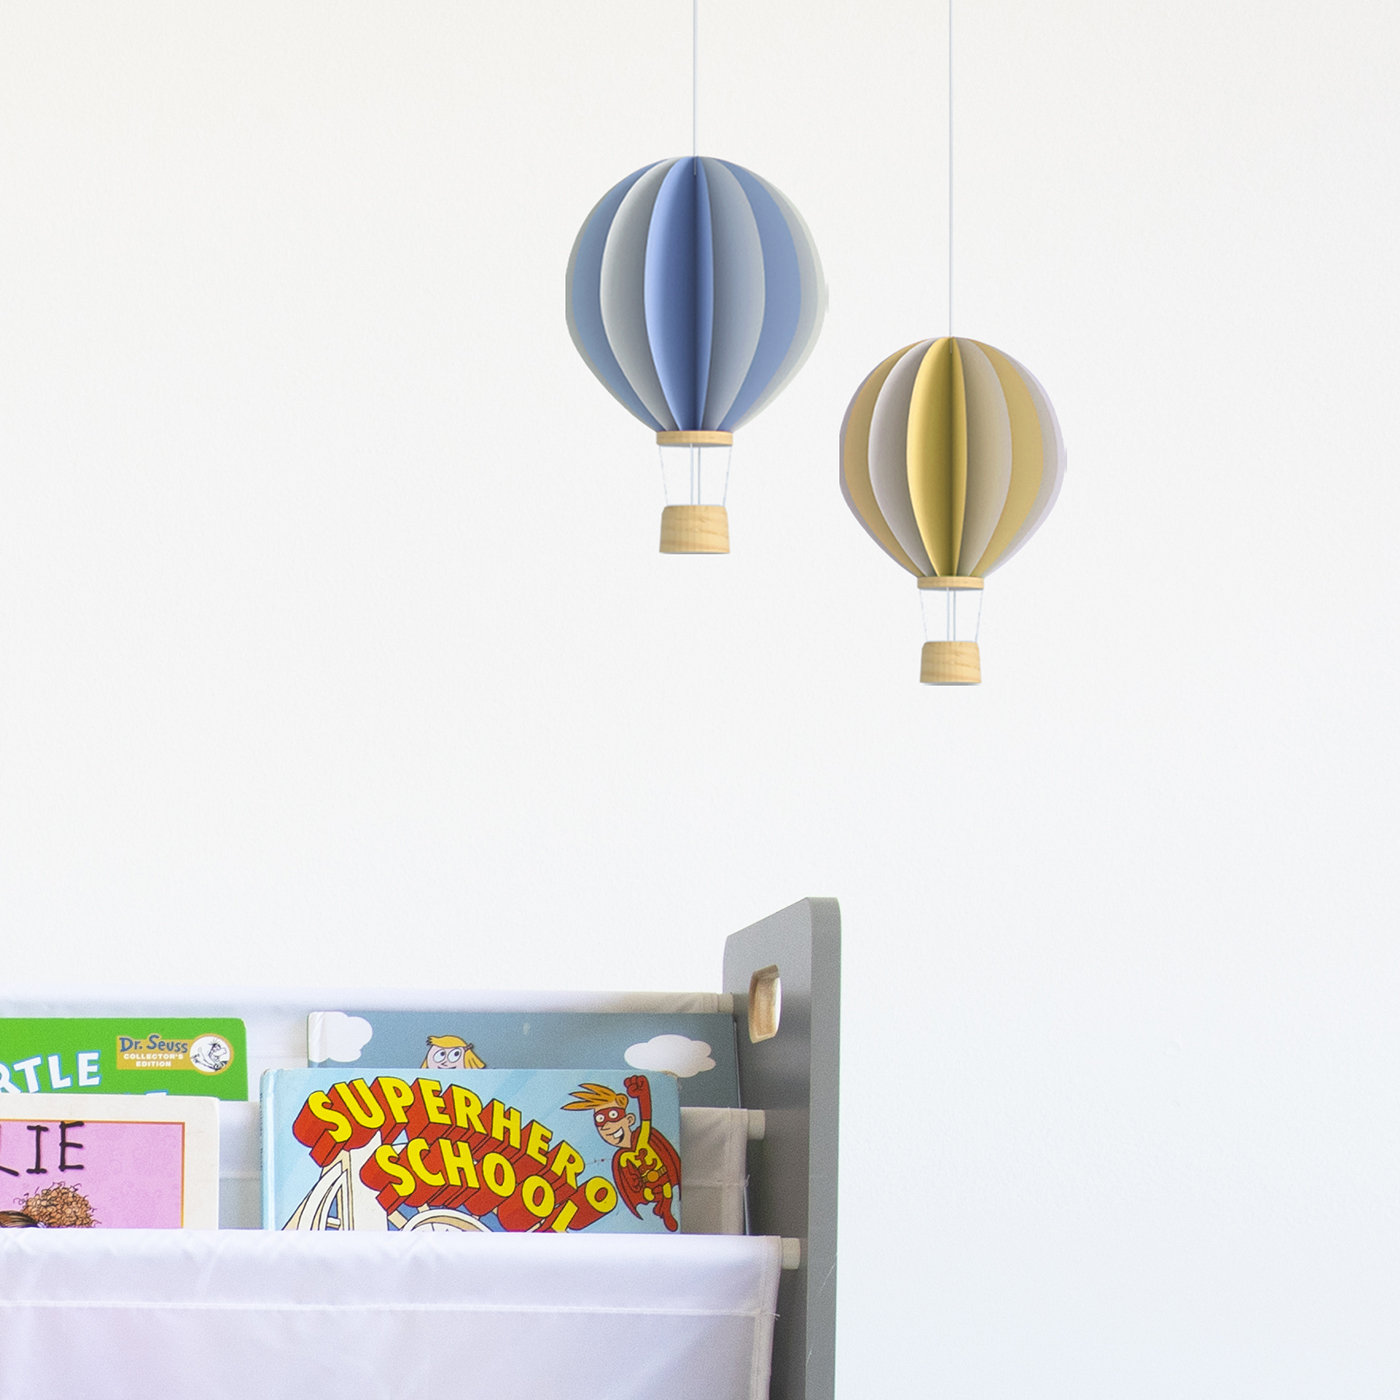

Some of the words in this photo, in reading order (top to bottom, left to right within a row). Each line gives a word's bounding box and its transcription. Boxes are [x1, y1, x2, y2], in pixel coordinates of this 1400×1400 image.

[119, 1037, 143, 1052] Dr.
[146, 1034, 188, 1054] Seuss
[296, 1075, 618, 1222] SUPERHERO
